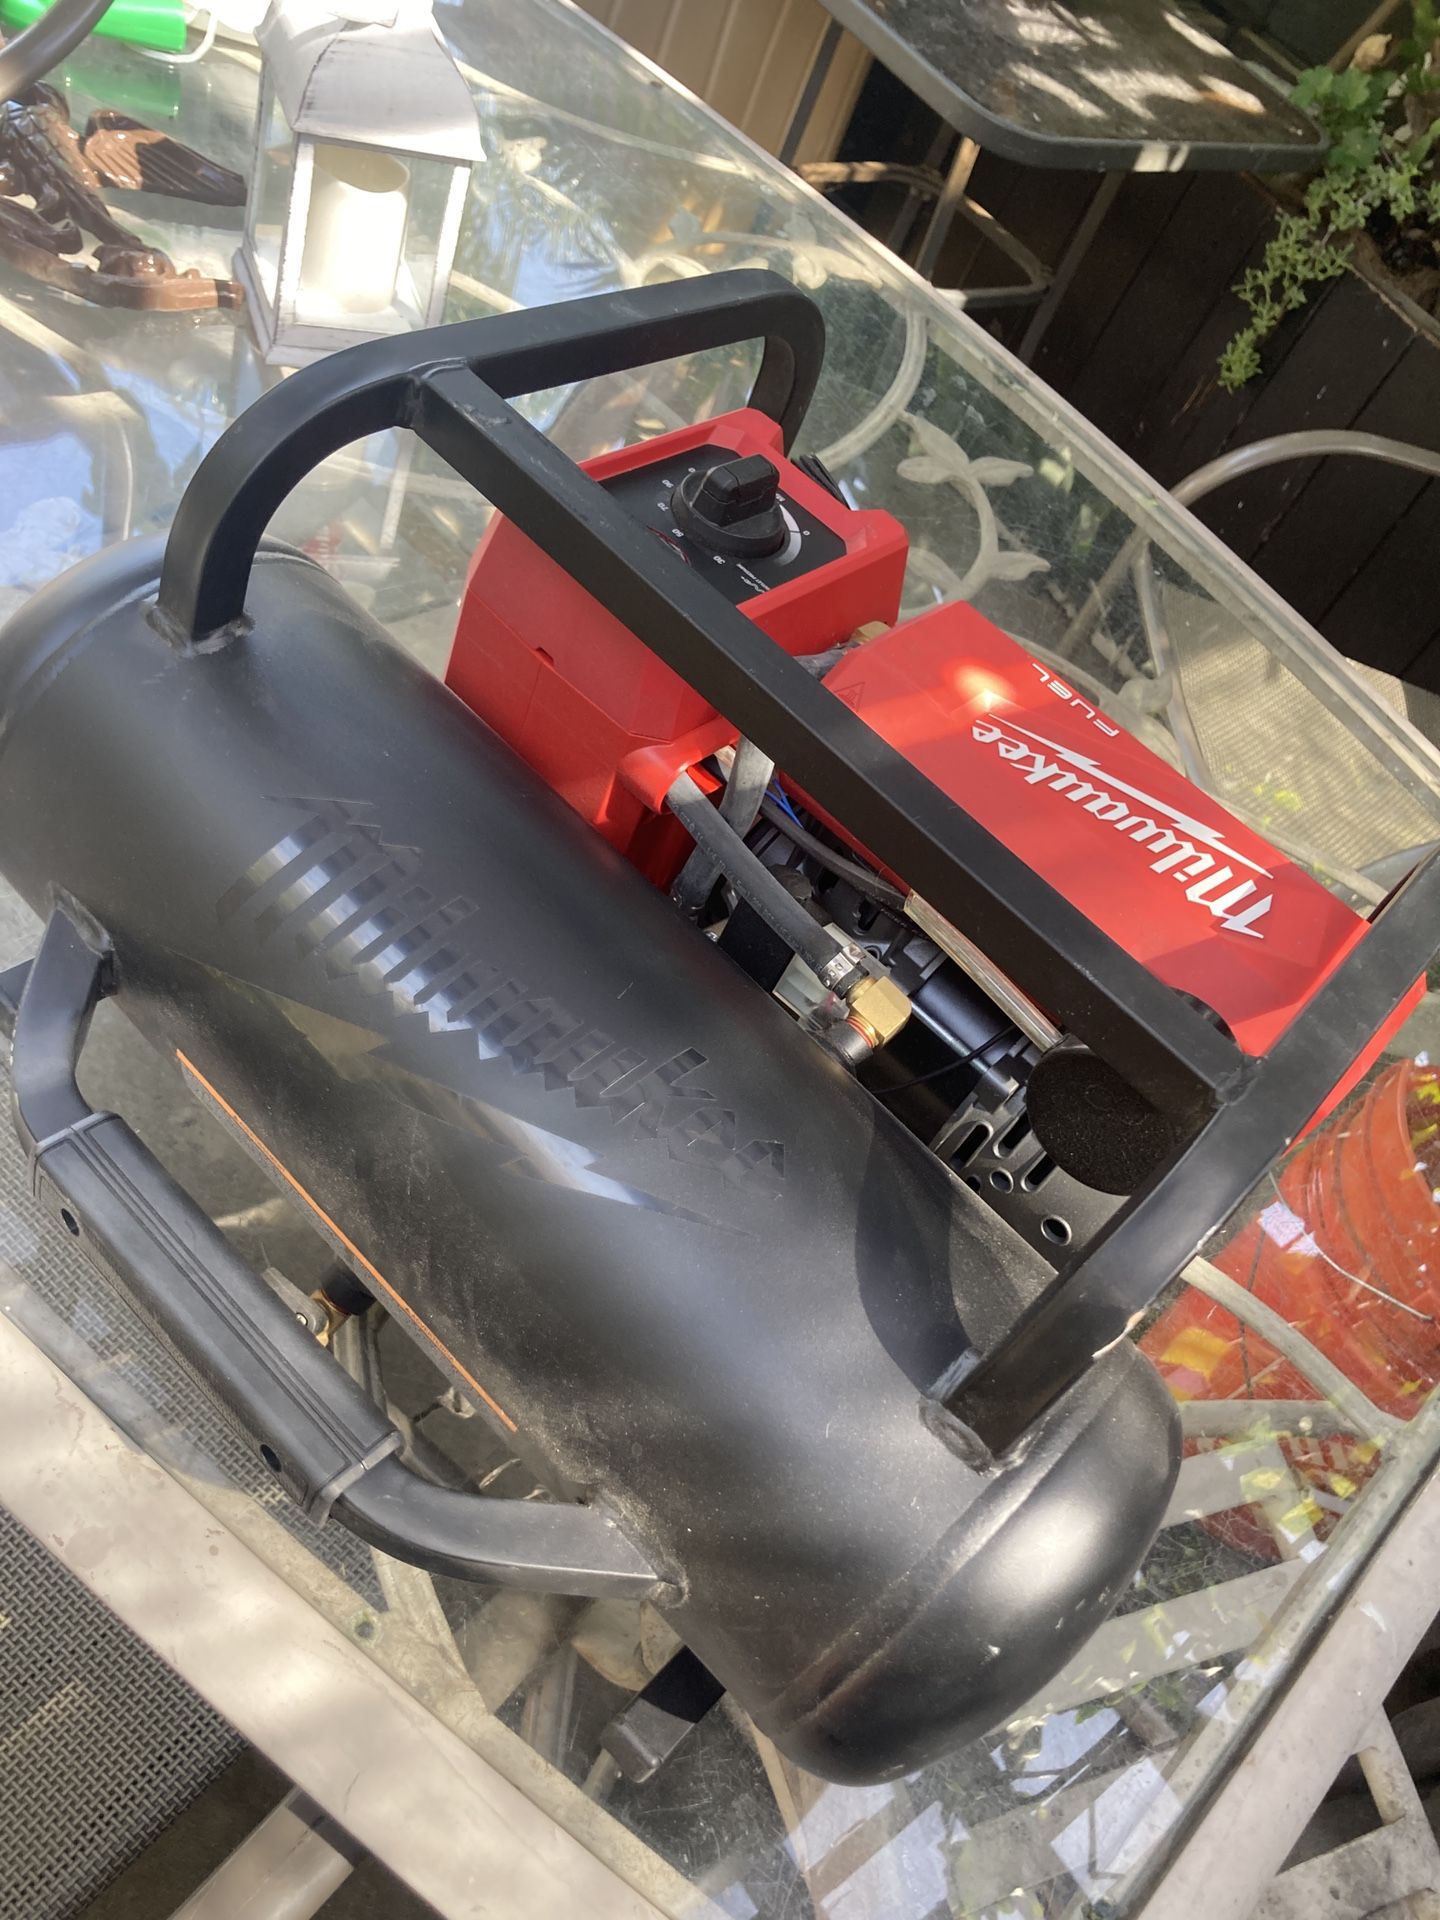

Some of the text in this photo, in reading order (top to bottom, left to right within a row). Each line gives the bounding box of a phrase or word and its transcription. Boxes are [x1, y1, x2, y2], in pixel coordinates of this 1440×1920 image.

[713, 555, 726, 565] 30
[1032, 663, 1119, 736] FUEL
[971, 718, 1274, 940] Milwaukee
